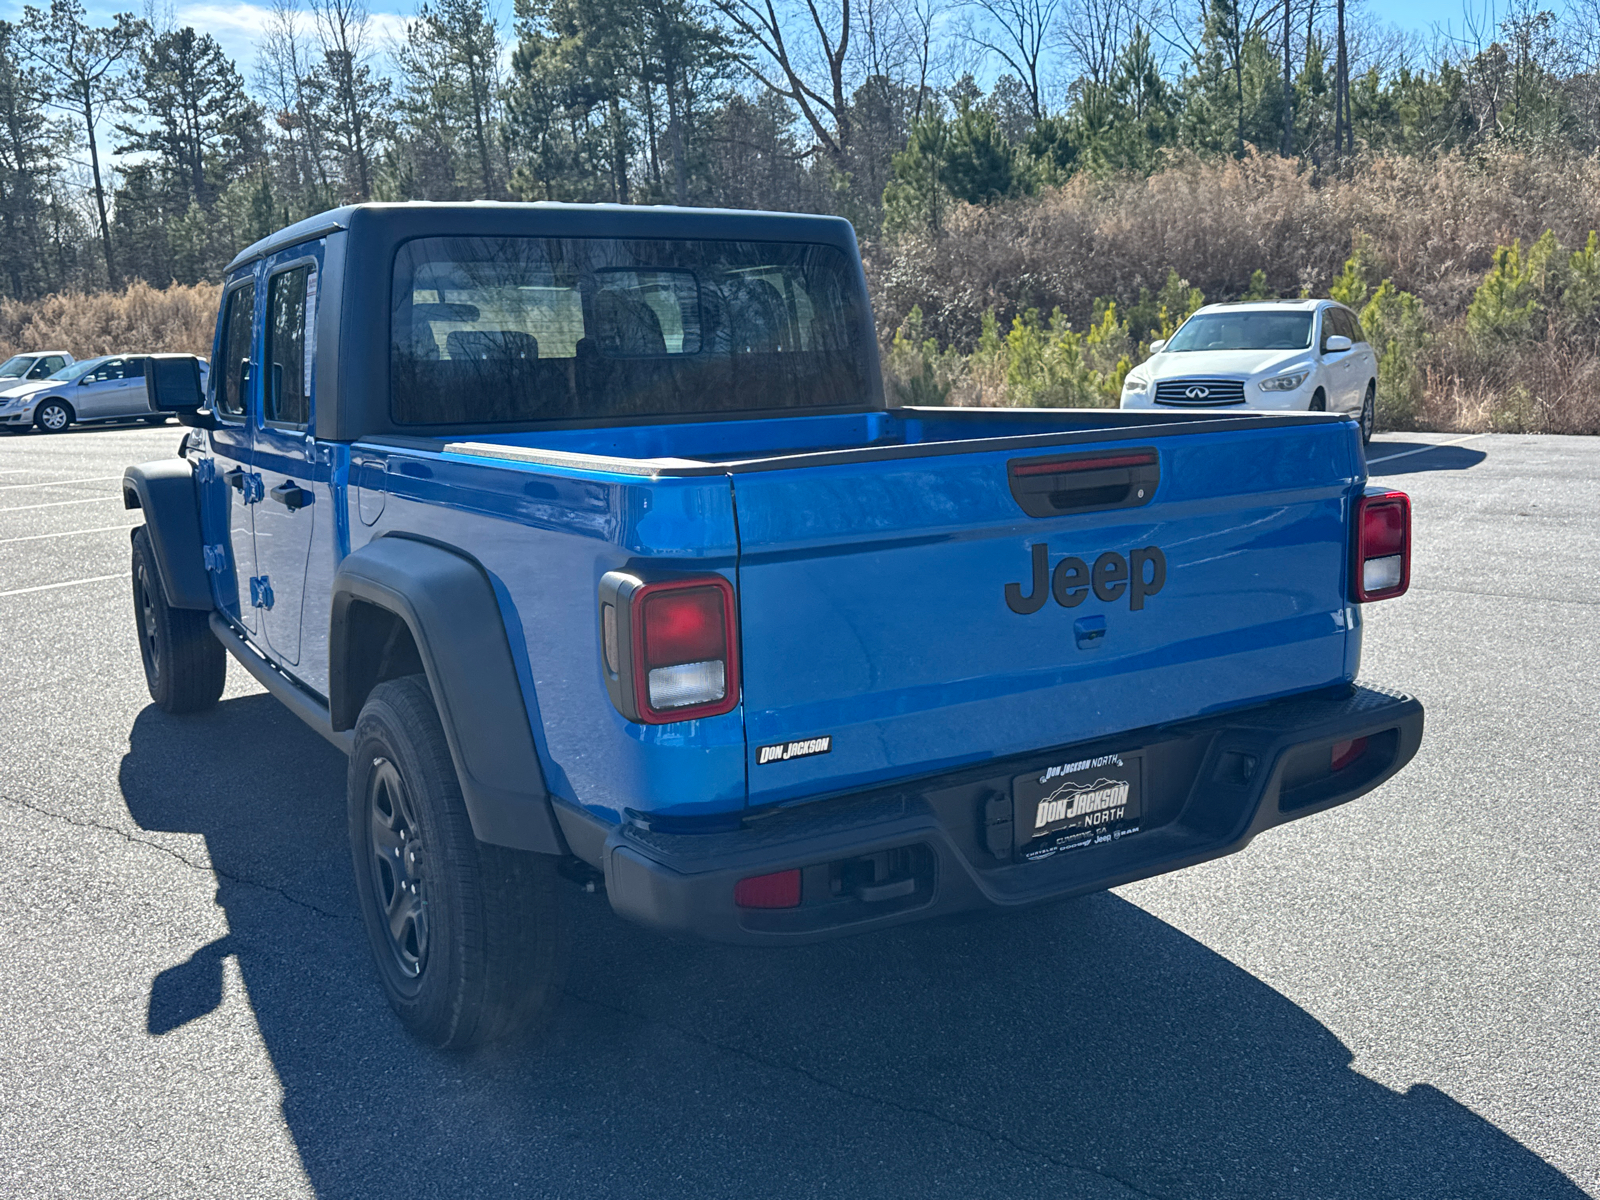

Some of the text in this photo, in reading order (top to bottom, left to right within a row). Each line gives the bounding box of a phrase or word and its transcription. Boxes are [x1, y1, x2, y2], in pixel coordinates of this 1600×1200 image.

[1004, 543, 1167, 615] Jeep
[1091, 754, 1119, 769] NORTH
[1084, 806, 1125, 827] NORTH
